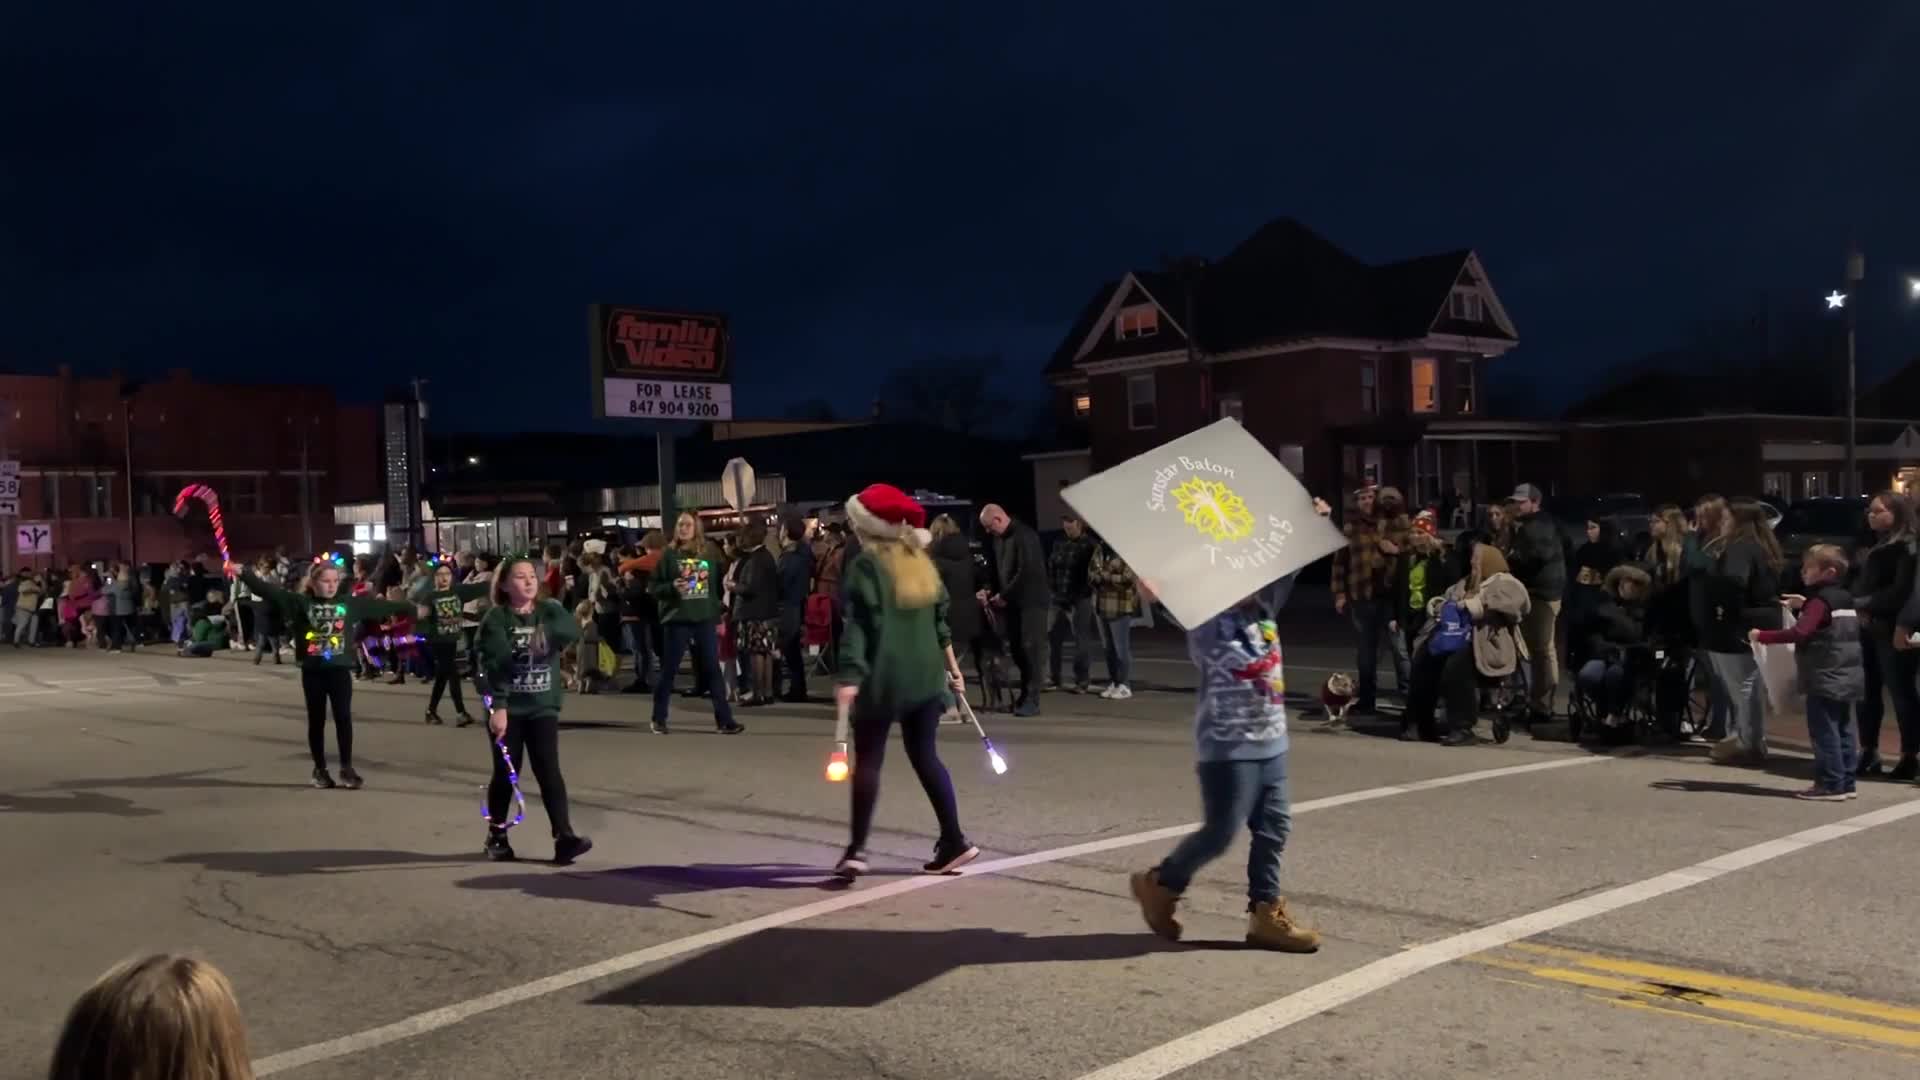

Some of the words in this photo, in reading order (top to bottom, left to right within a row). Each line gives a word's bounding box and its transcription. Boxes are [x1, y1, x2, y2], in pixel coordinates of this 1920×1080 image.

[636, 383, 662, 397] FOR
[673, 385, 712, 400] LEASE
[629, 400, 654, 414] 847
[659, 401, 684, 415] 904
[688, 403, 719, 416] 9200
[1145, 463, 1179, 513] Sunstar
[1177, 455, 1236, 479] Baton
